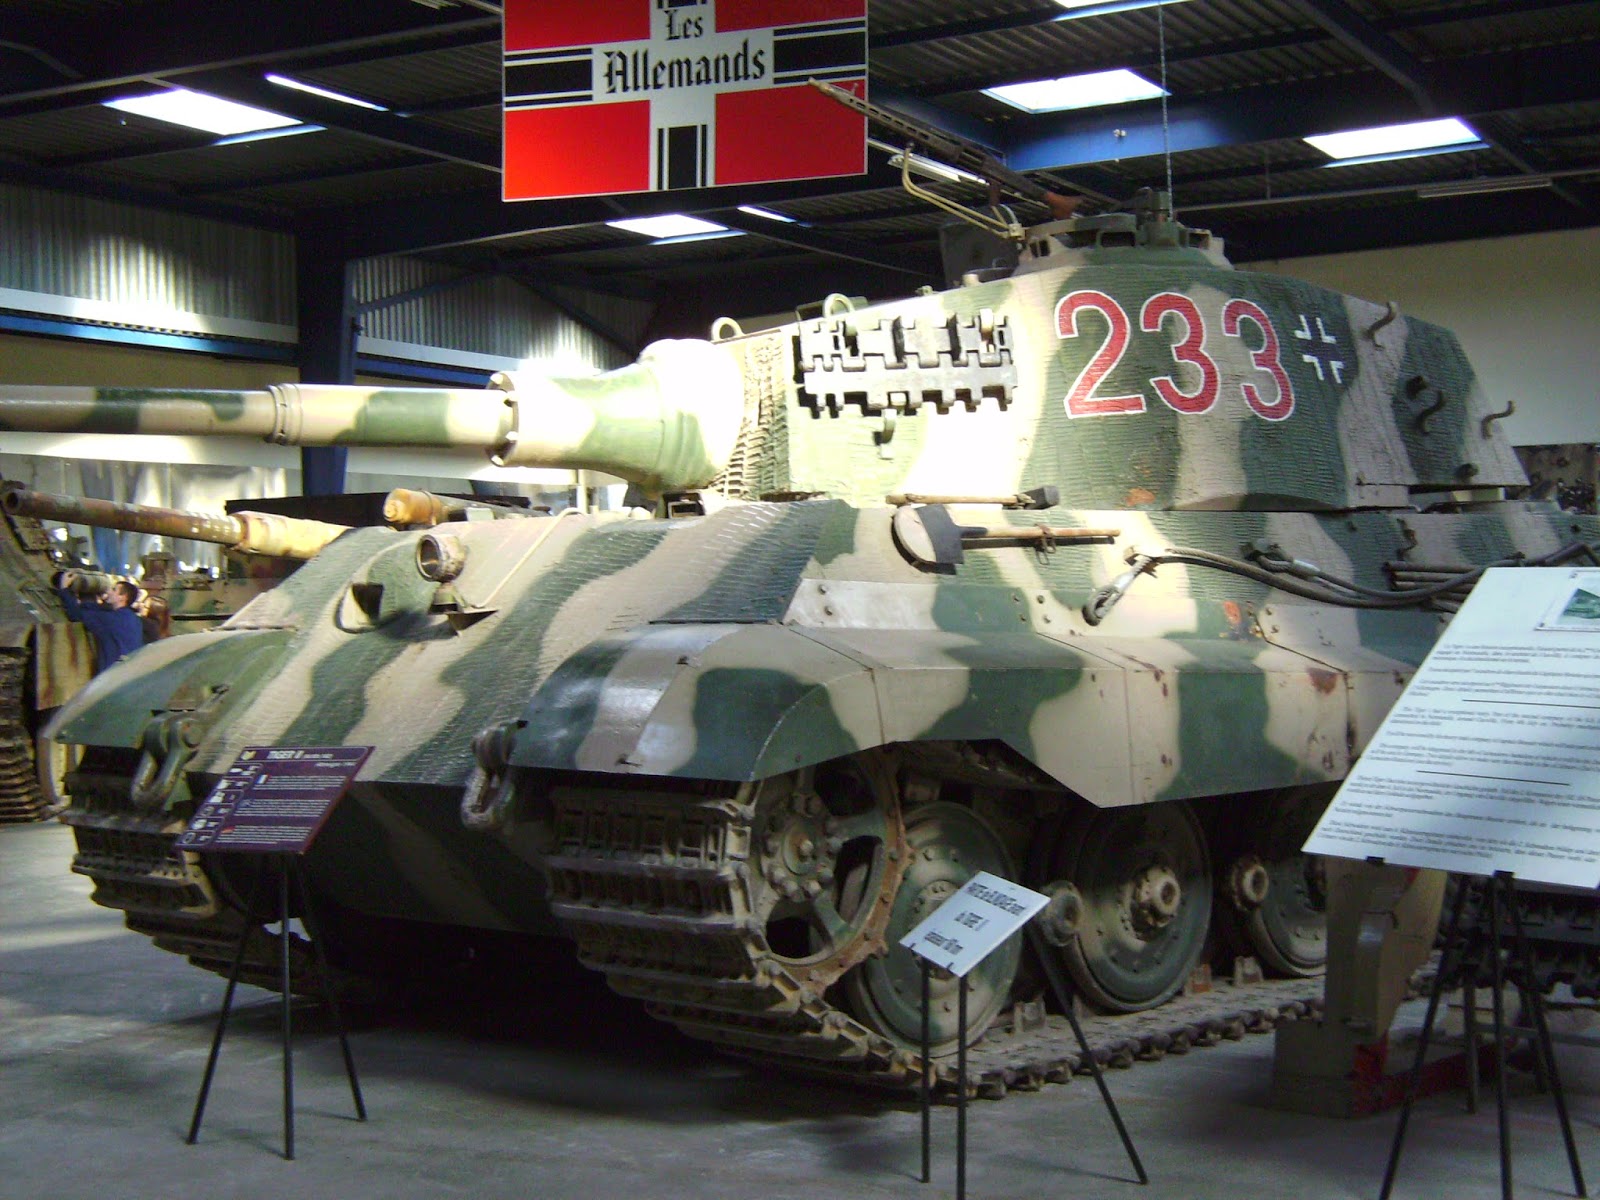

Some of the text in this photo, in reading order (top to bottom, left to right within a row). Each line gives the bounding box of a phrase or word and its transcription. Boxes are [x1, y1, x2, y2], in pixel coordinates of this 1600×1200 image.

[664, 9, 703, 40] Les
[603, 38, 766, 94] Allemands
[1055, 290, 1295, 421] 233
